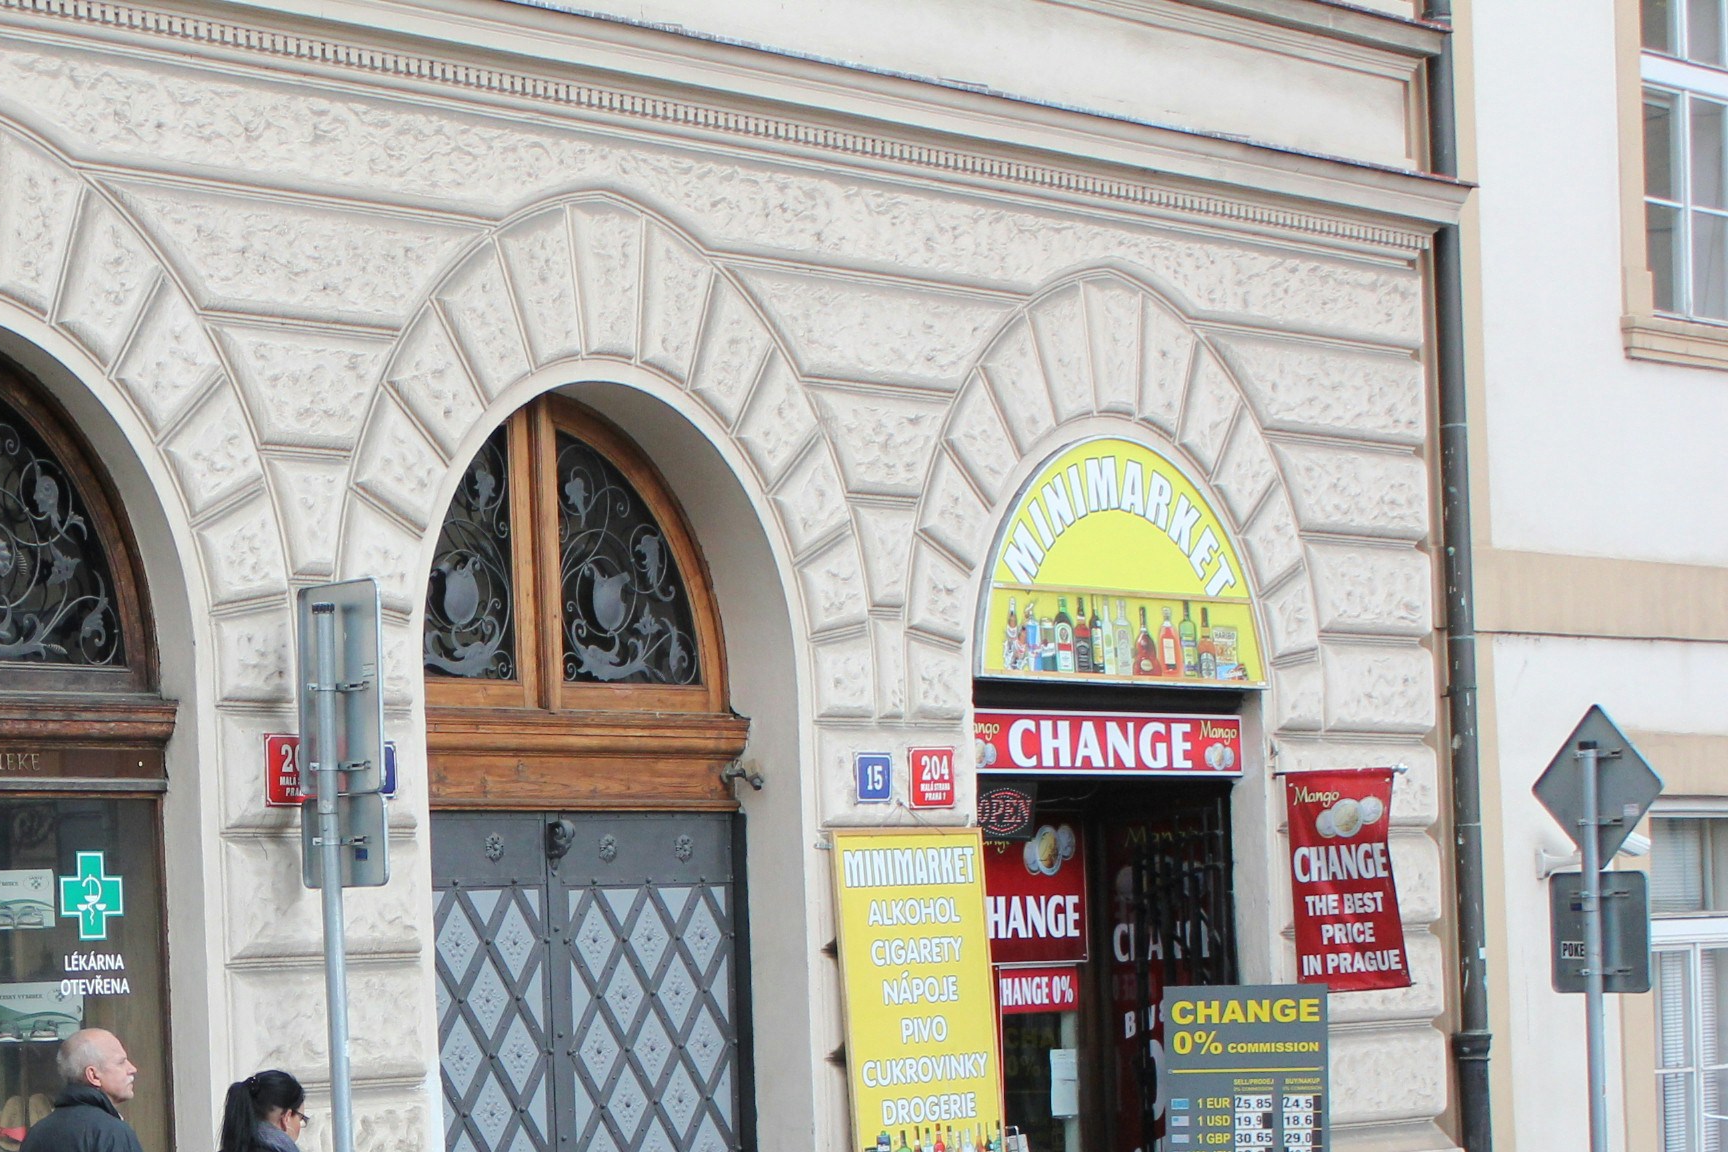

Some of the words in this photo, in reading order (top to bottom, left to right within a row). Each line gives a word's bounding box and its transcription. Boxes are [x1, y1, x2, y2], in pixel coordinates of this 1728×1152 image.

[1003, 455, 1236, 598] MINIMARKET
[974, 722, 1000, 741] ango
[1008, 719, 1192, 768] CHANGE
[1199, 720, 1237, 744] Mango
[280, 774, 297, 786] MALÁ
[867, 765, 883, 790] 15
[921, 755, 949, 780] 204
[285, 787, 304, 797] PRA
[925, 792, 942, 801] PRAHA
[1293, 786, 1339, 807] Mango
[978, 799, 1032, 823] OPEN
[843, 847, 975, 888] MINIMARKET
[1293, 842, 1389, 883] CHANGE
[868, 897, 961, 926] ALKOHOL
[1305, 893, 1339, 916] THE
[1343, 891, 1383, 914] BEST
[986, 895, 1080, 939] HANGE
[1321, 922, 1375, 945] PRICE
[64, 951, 124, 972] LÉKÁRNA
[871, 936, 963, 967] CIGARETY
[1302, 955, 1322, 976] IN
[1326, 949, 1402, 974] PRAGUE
[60, 975, 130, 996] OTEVŘENA
[882, 970, 959, 1006] NÁPOJE
[1000, 976, 1049, 1006] HANGE
[1052, 975, 1073, 1003] 0%
[1171, 998, 1320, 1025] CHANGE
[900, 1015, 948, 1044] PIVO
[1173, 1030, 1223, 1055] 0%
[1227, 1041, 1319, 1054] COMMISSION
[862, 1052, 988, 1088] CUKROVINKY
[881, 1092, 977, 1126] DROGERIE
[1197, 1098, 1202, 1108] 1
[1207, 1098, 1230, 1108] EUR
[1197, 1116, 1202, 1126] 1
[1207, 1116, 1231, 1126] USD
[1197, 1134, 1202, 1144] 1
[1206, 1134, 1231, 1144] GBP
